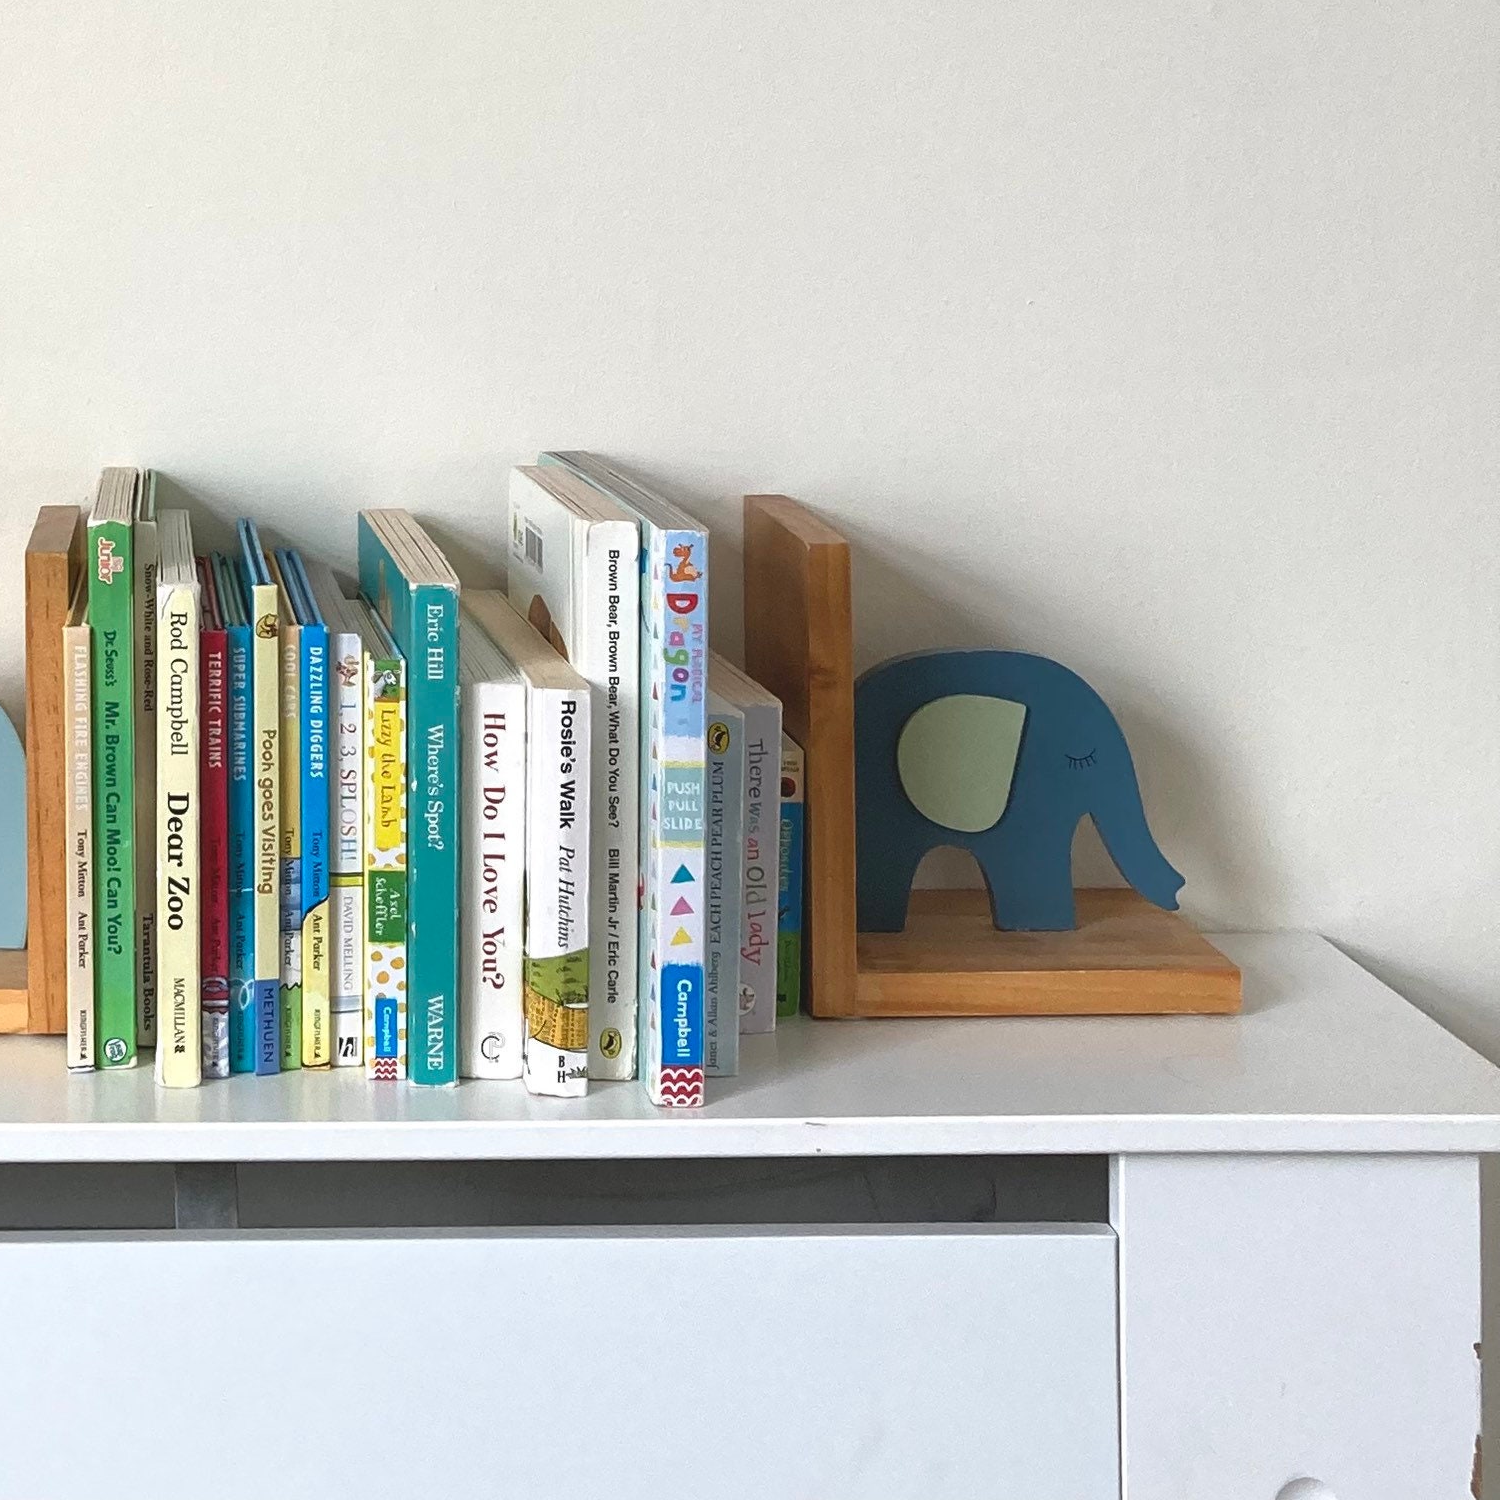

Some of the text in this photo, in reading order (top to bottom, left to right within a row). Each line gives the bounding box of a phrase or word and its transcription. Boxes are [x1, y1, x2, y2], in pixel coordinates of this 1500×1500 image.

[144, 563, 155, 712] Snow-White and Rose-Red
[427, 603, 444, 680] Eric Hill
[663, 593, 698, 702] Dragon
[104, 649, 118, 687] Seuss's
[166, 612, 188, 755] Rod Campbell
[606, 549, 620, 828] Brown Bear, Brown Bear, What Do You See?
[74, 645, 89, 812] FLASHING FIRE ENGINES
[104, 701, 119, 730] Mr.
[208, 652, 222, 768] TERRIFIC TRAINS
[233, 647, 246, 781] SUPER SUBMARINES
[309, 646, 324, 778] DAZZLING DIGGERS
[105, 734, 120, 788] Brown
[262, 729, 277, 771] Pooh
[377, 710, 397, 828] Lizzy the Lamb
[559, 700, 577, 829] Rosie's Walk
[258, 777, 274, 821] goes
[424, 724, 445, 850] Where's Spot?
[667, 781, 700, 795] PUSH
[668, 800, 698, 811] PULL
[712, 761, 724, 803] PLUM
[106, 792, 120, 824] Can
[340, 769, 357, 861] SPLOSH!
[663, 817, 702, 830] SLIDE
[712, 807, 723, 847] PEAR
[106, 828, 122, 872] Moo!
[167, 792, 190, 931] Dear Zoo
[482, 713, 506, 989] How Do I Love You?
[608, 848, 620, 869] Bill
[711, 851, 722, 899] PEACH
[741, 738, 769, 966] There was an Old lady
[75, 830, 89, 969] Tony Mitton Ant Parker
[107, 877, 122, 909] Can
[284, 828, 295, 967] Tony Mitton Ant Parker
[310, 830, 325, 970] Tony Mitton Ant Parker
[375, 877, 388, 936] Scheffler
[389, 889, 402, 920] Axel
[558, 845, 575, 948] Pat Hutchins
[608, 872, 620, 913] Martin
[107, 913, 122, 955] You?
[343, 896, 353, 991] DAVID MELLING
[608, 916, 620, 927] Jr
[710, 903, 721, 944] EACH
[142, 913, 155, 1031] Tarantula Books
[236, 935, 247, 970] Parker
[608, 941, 619, 967] Eric
[709, 951, 721, 994] Ahlberg
[173, 977, 186, 1044] MACMILLAN
[607, 970, 619, 1004] Carle
[708, 997, 718, 1027] Allan
[263, 988, 274, 1063] METHUEN
[382, 1006, 392, 1053] Campbell
[427, 995, 444, 1070] WARNE
[673, 979, 693, 1057] Campbell
[557, 1071, 566, 1083] H
[558, 1055, 565, 1068] B
[707, 1041, 718, 1070] Janet
